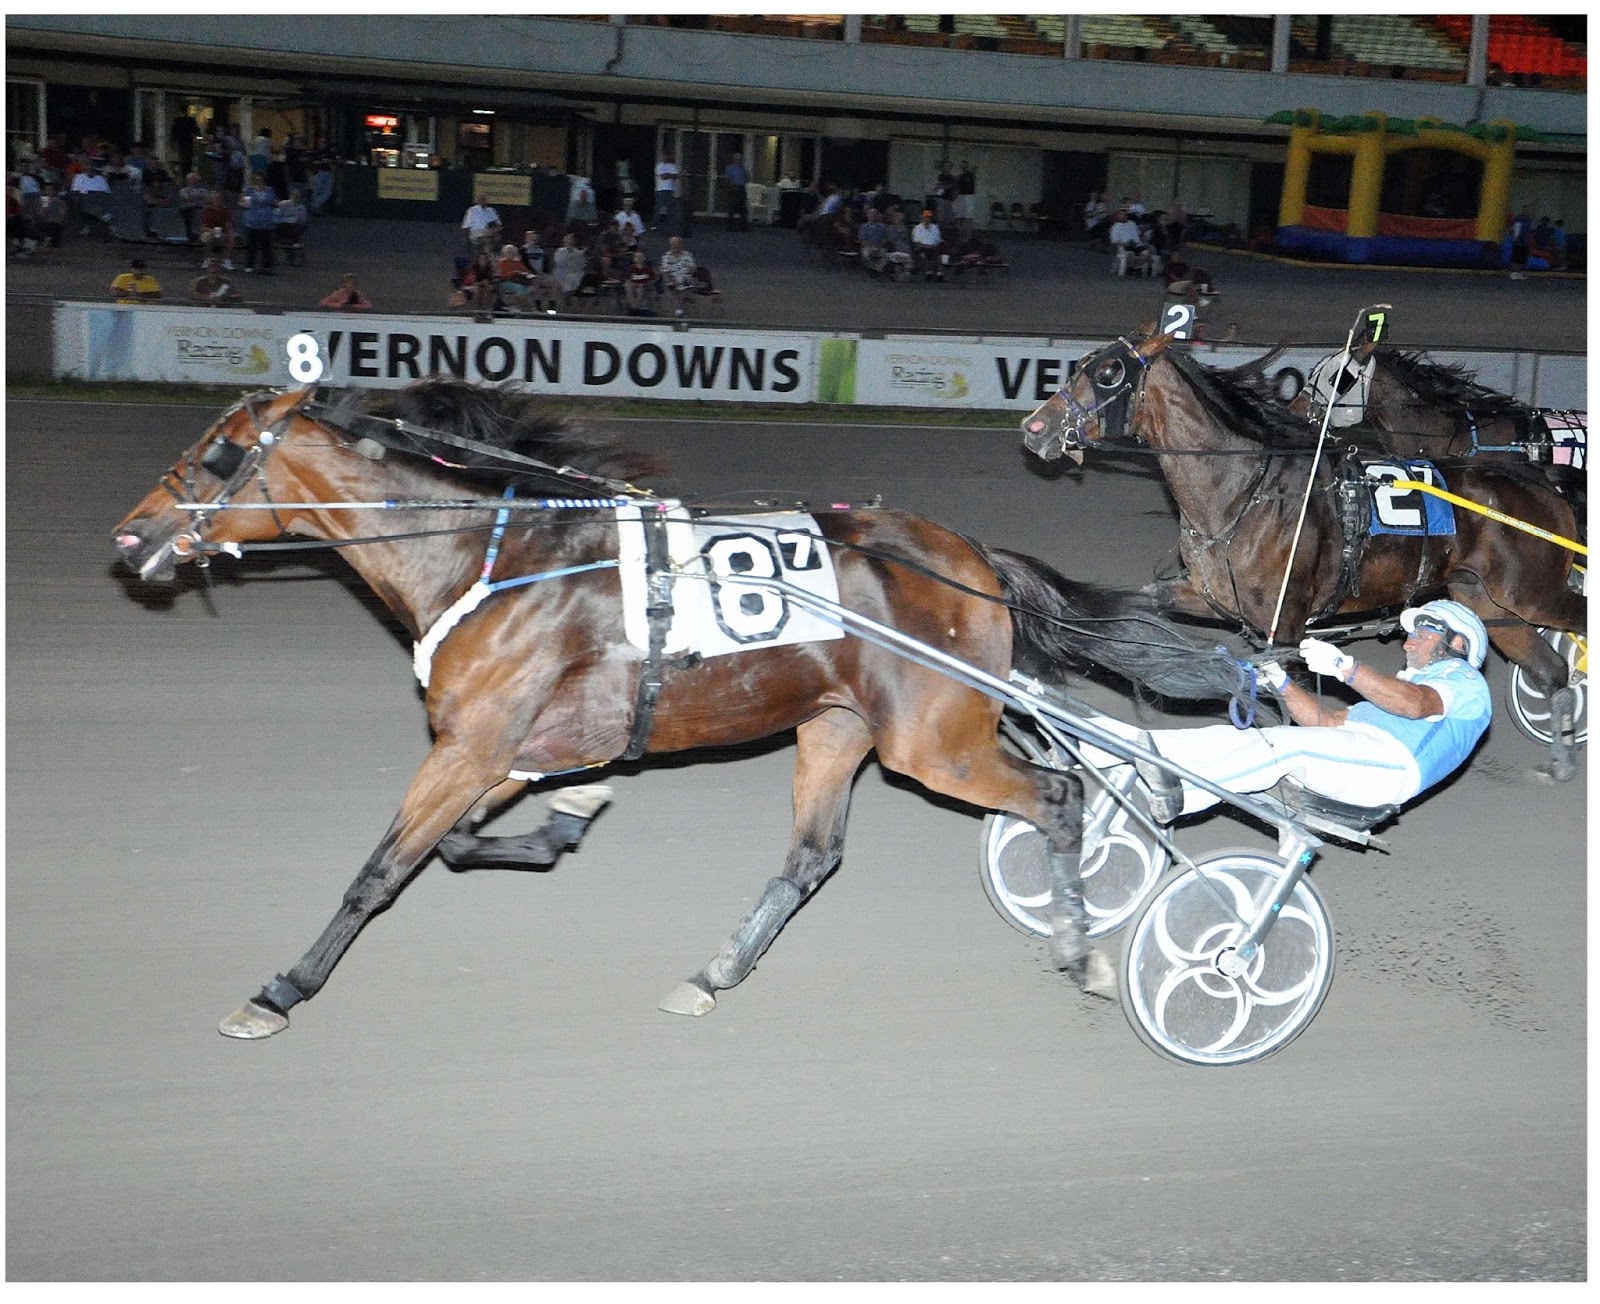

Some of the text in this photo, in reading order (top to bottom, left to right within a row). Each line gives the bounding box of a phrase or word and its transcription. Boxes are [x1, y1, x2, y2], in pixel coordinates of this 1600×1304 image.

[1164, 304, 1190, 340] 2
[1367, 312, 1385, 343] 7
[286, 333, 324, 383] 8
[583, 340, 800, 393] DOWNS
[1365, 464, 1422, 526] 2
[702, 533, 812, 642] 8 7
